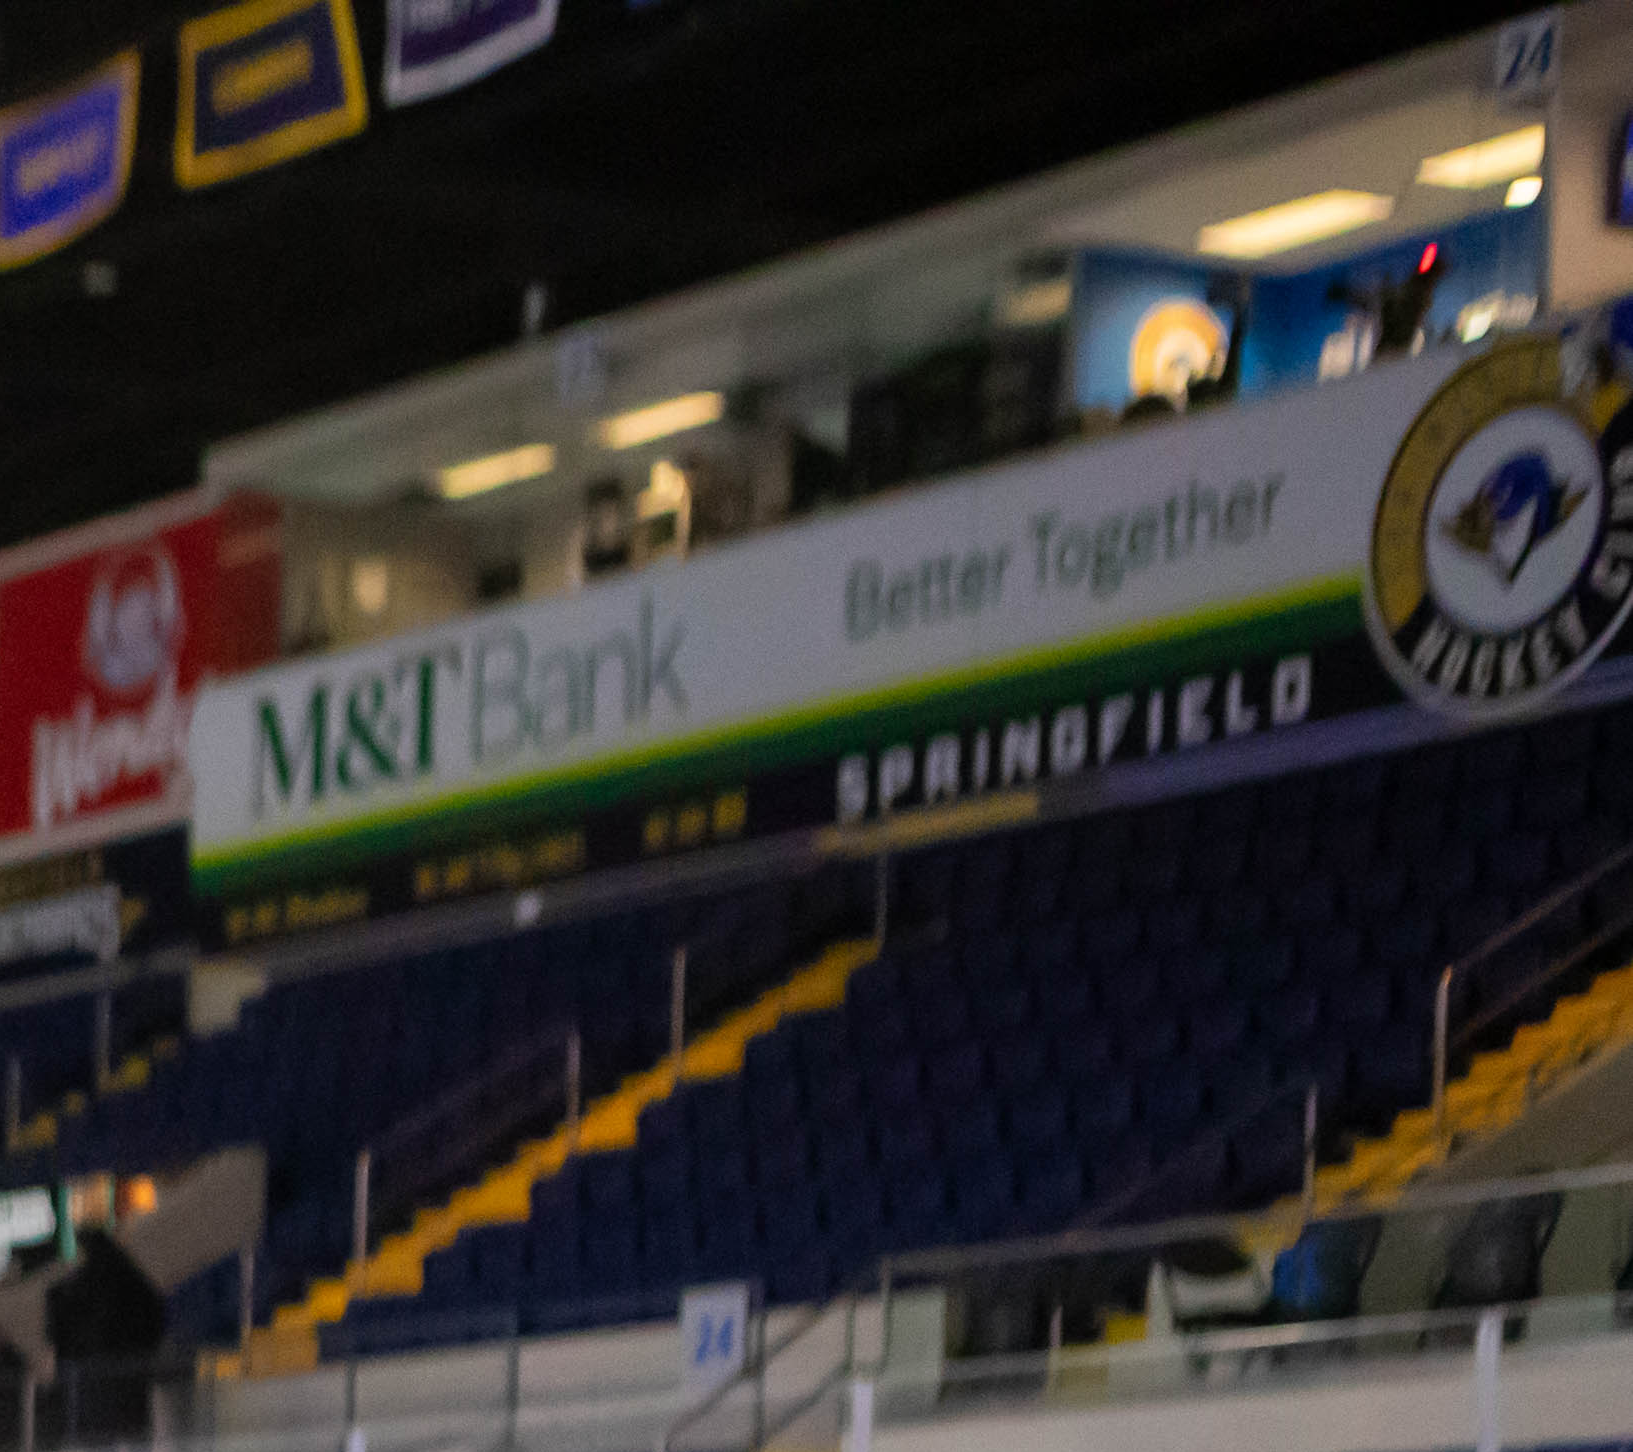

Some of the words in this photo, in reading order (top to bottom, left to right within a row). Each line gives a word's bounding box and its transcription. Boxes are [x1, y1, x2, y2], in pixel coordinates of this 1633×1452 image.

[844, 543, 1011, 643] Better
[1029, 471, 1285, 600] Together
[251, 640, 463, 822] M&T
[471, 594, 693, 764] Bank
[836, 653, 1314, 824] SPRINGFIELD
